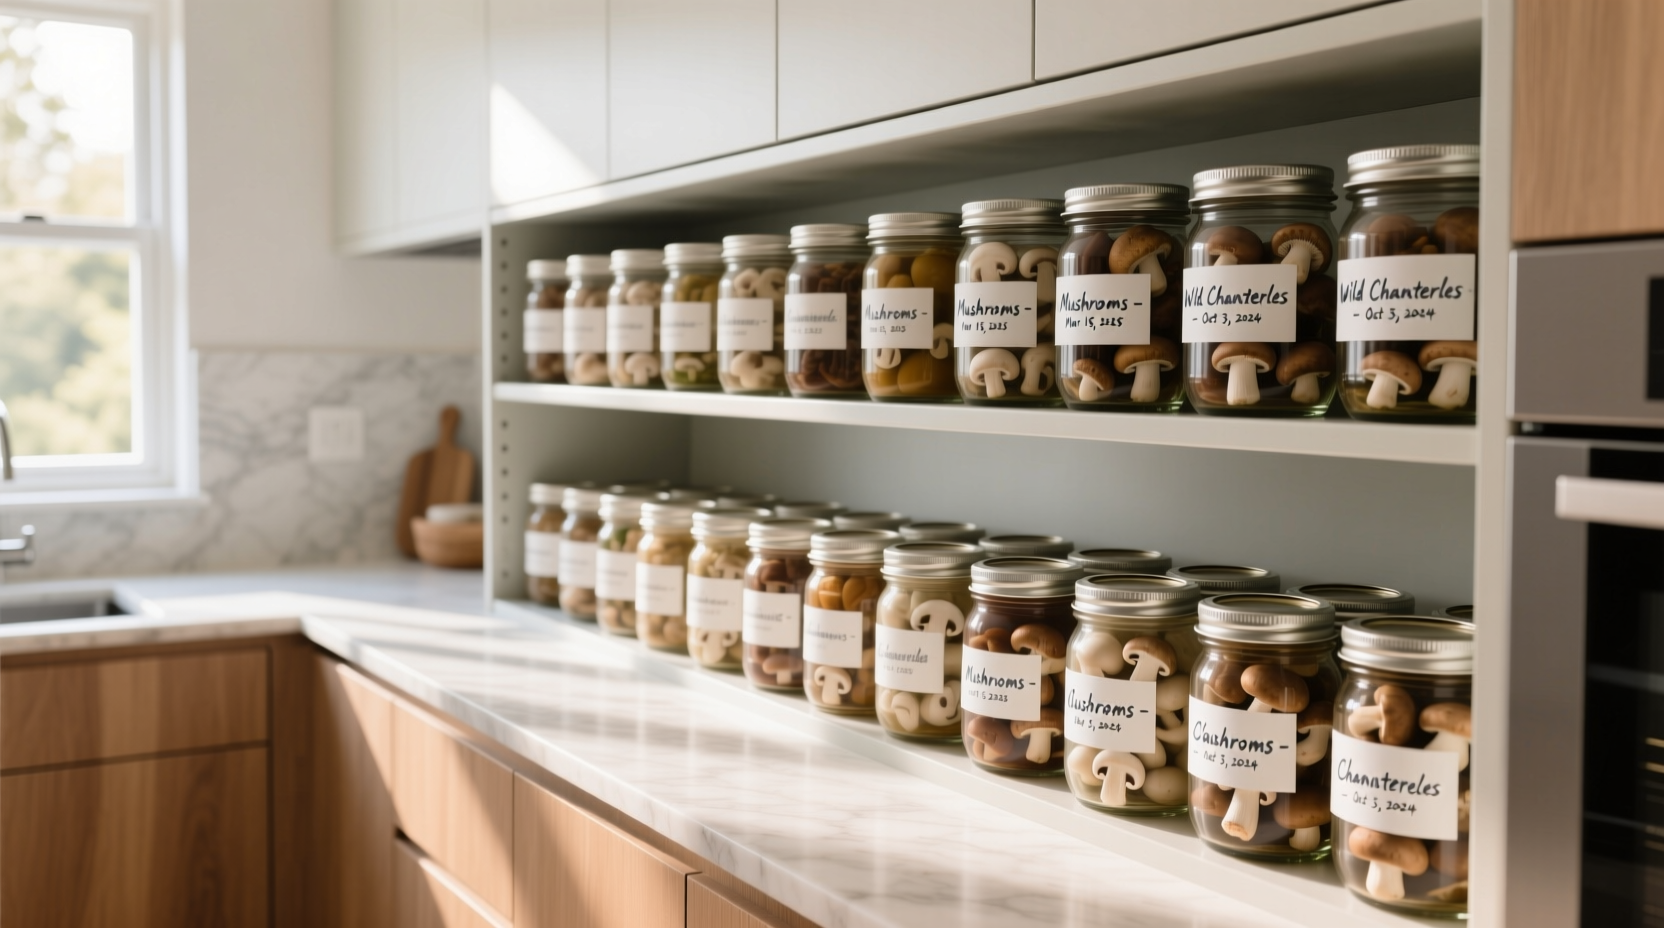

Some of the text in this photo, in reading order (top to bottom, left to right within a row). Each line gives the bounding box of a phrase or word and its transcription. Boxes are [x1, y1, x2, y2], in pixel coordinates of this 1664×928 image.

[1207, 283, 1289, 306] Chanterles
[1369, 276, 1463, 302] Chanterles
[1202, 312, 1217, 324] Oct
[1222, 313, 1231, 326] 3,
[1235, 312, 1262, 323] 2024
[1365, 306, 1384, 321] Oct
